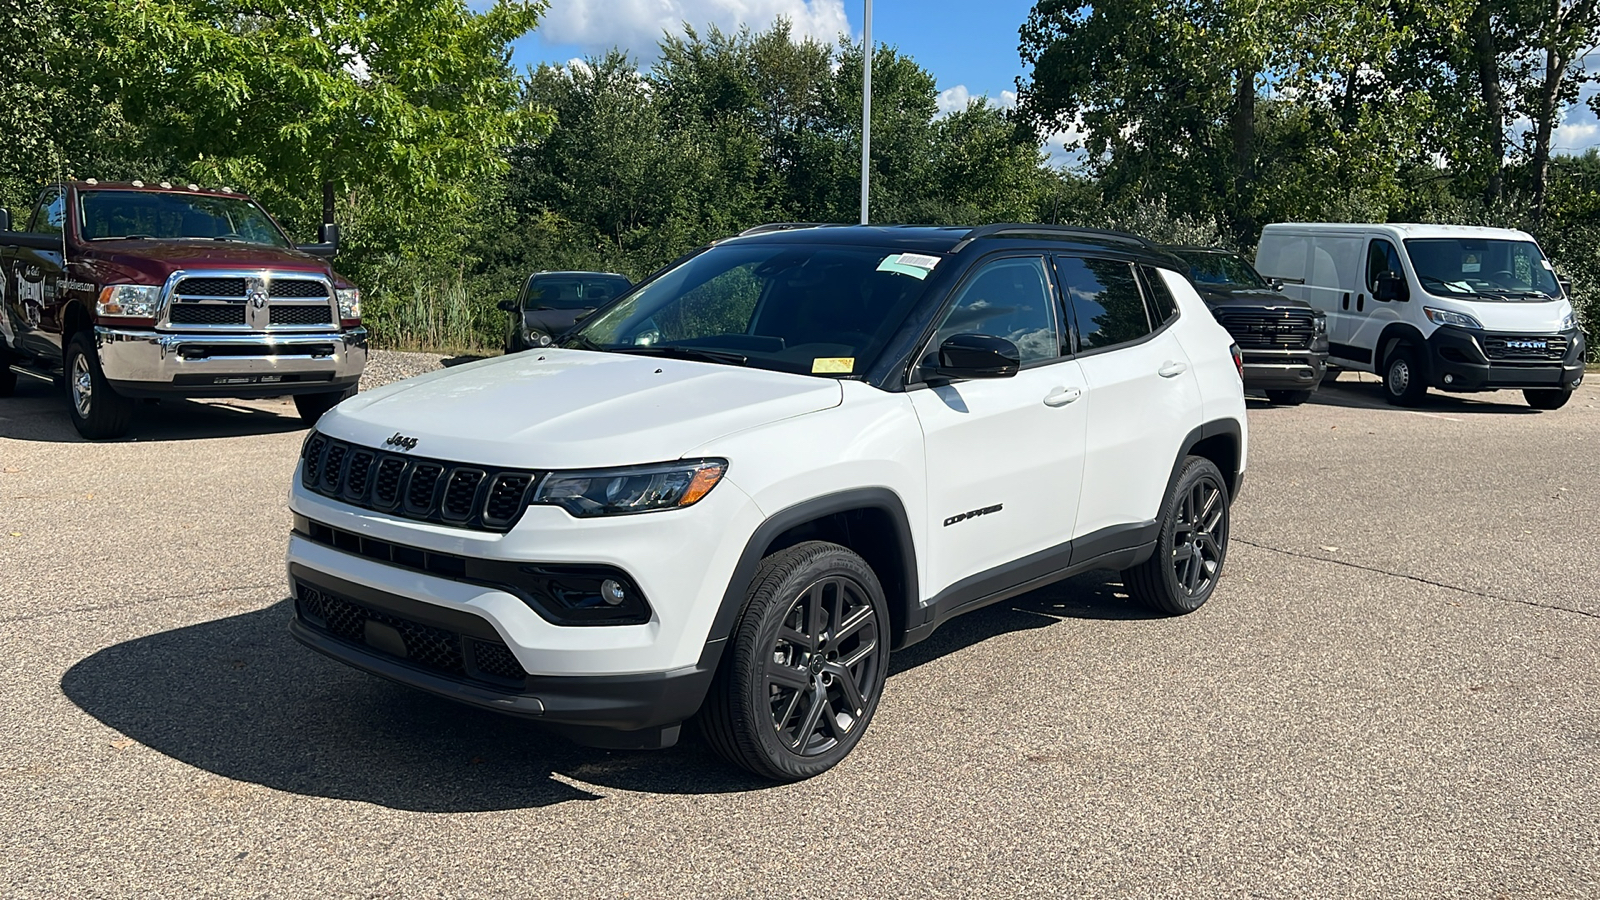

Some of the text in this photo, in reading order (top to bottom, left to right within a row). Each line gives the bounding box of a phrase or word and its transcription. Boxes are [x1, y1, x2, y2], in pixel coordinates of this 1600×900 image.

[1506, 341, 1547, 349] RAM
[386, 431, 419, 451] Jeep
[943, 502, 1004, 528] COMPASS
